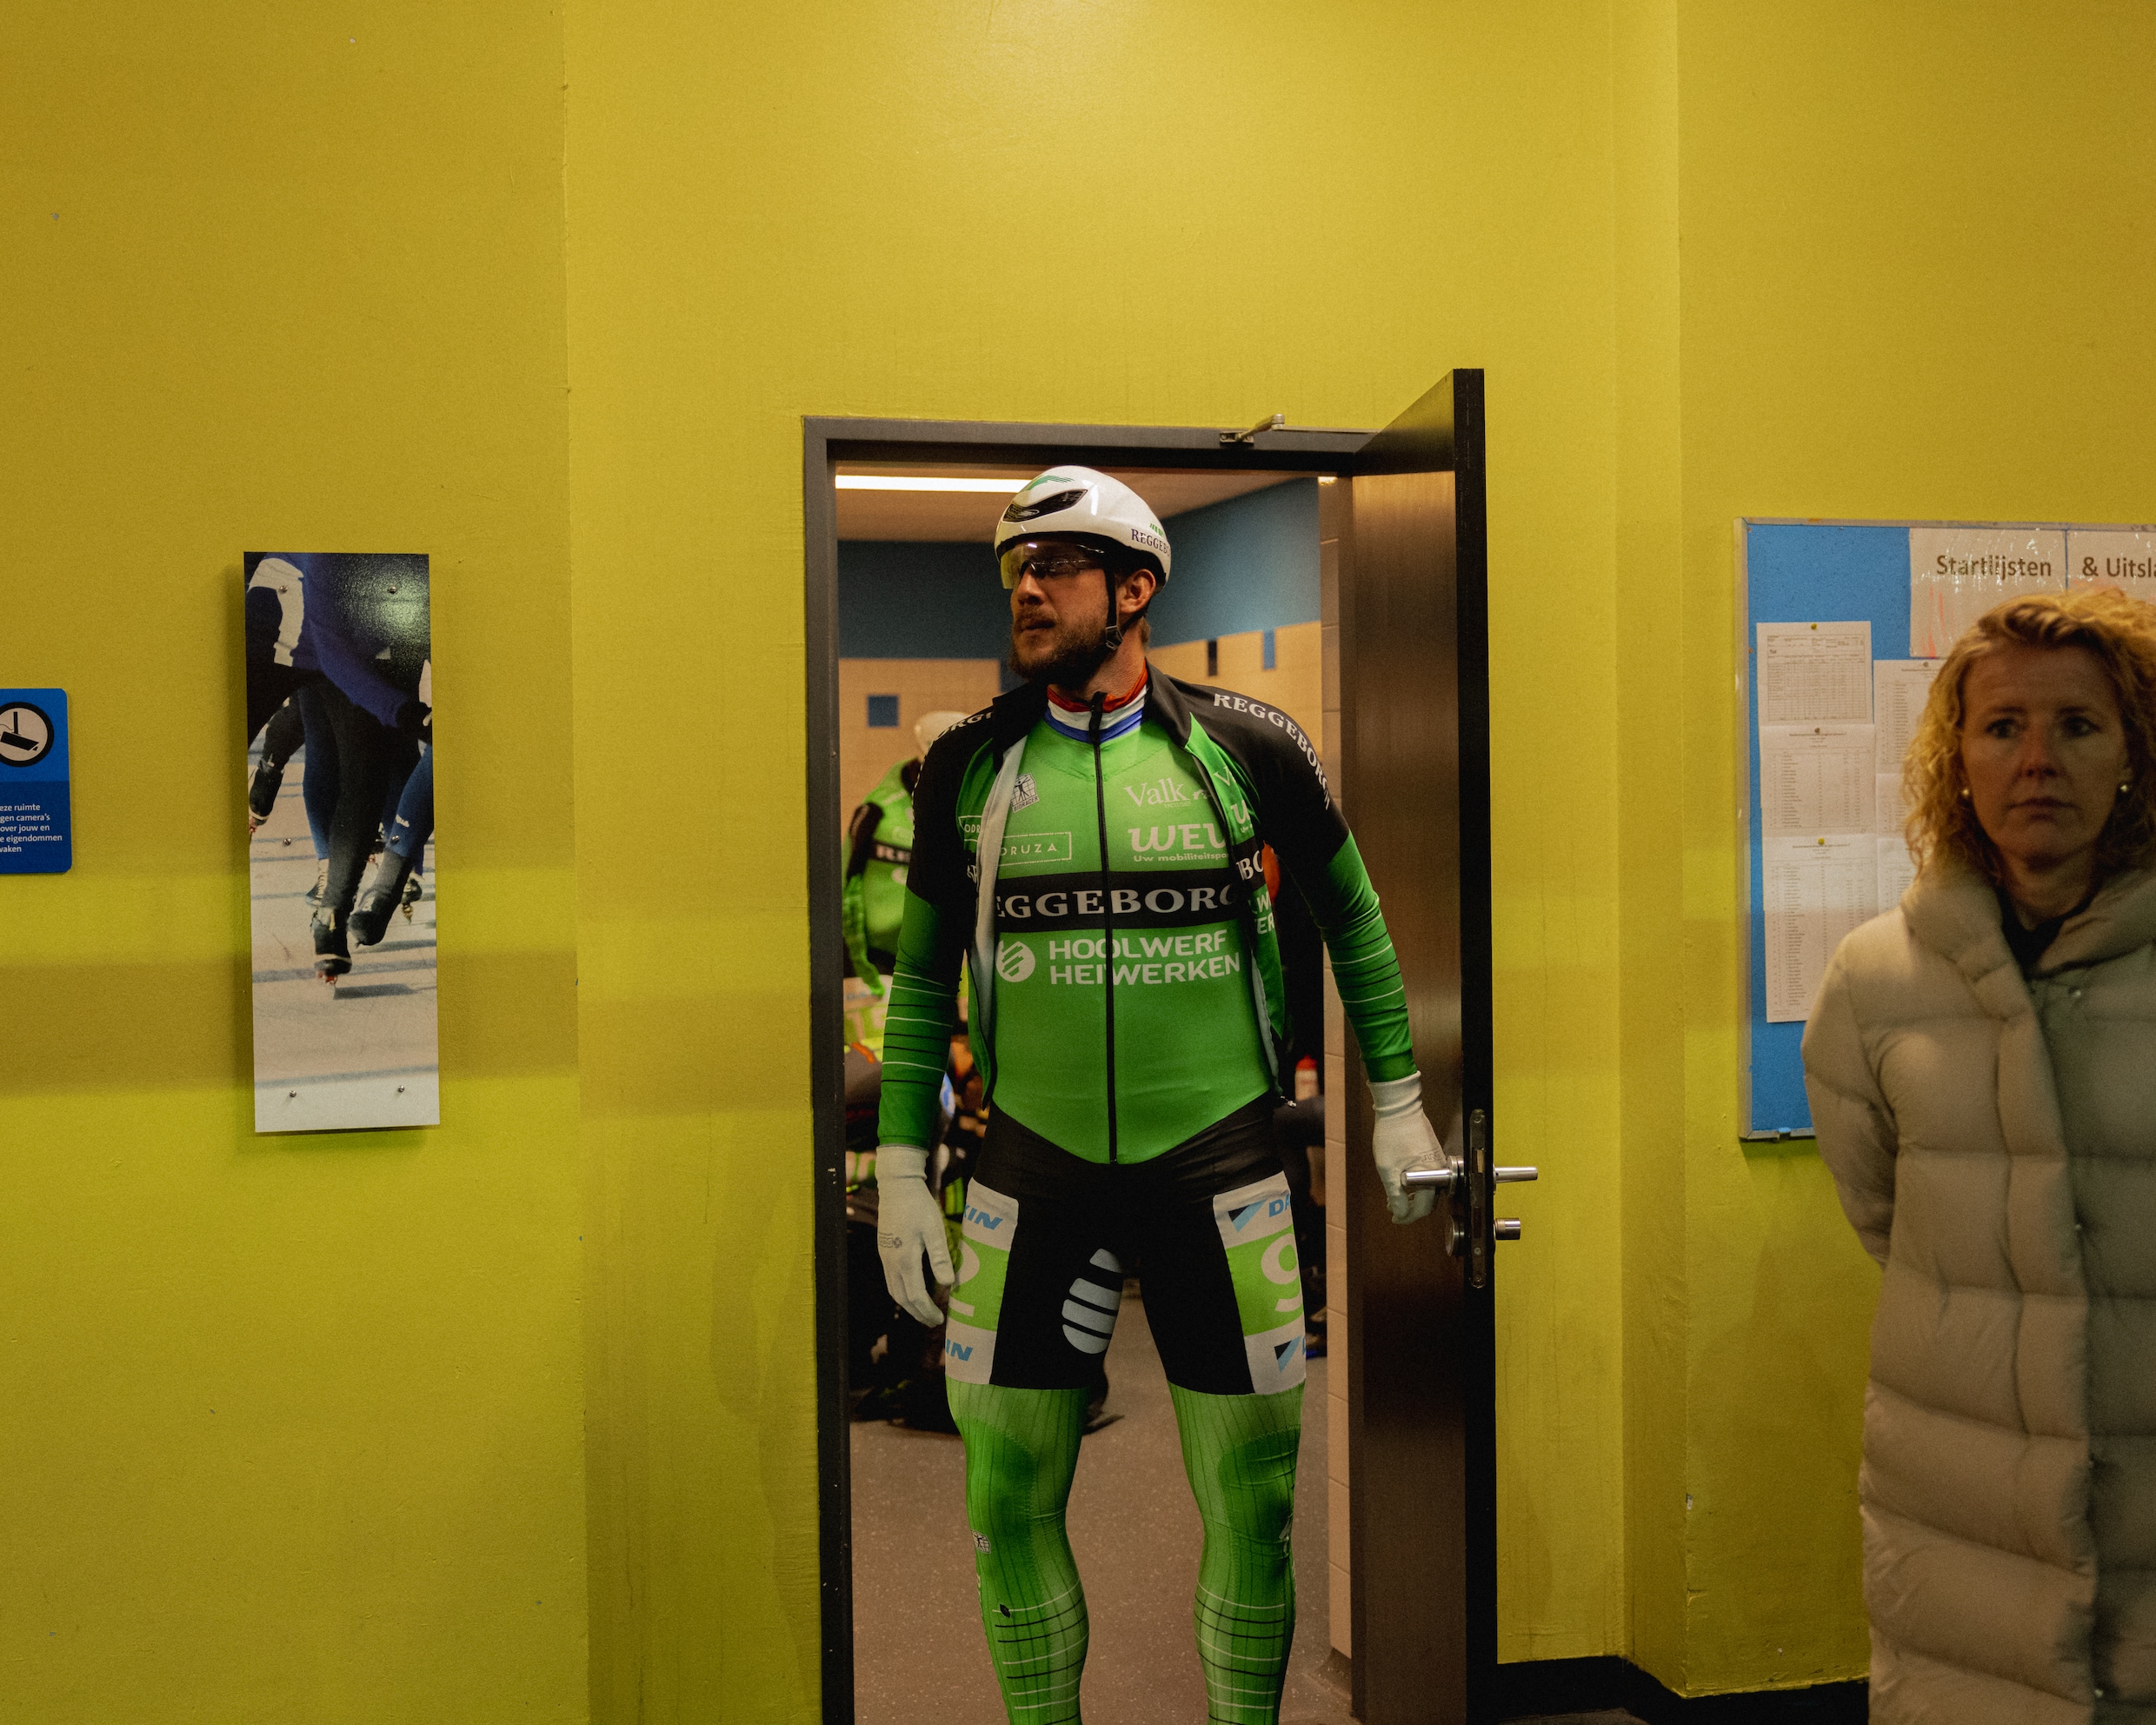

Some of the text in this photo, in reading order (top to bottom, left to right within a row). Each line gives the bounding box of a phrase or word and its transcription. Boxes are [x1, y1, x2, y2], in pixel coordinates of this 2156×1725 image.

[1936, 555, 2156, 580] Startlijsten & Uitsl
[1123, 777, 1190, 808] Valk
[1013, 796, 1039, 812] BIORACER
[17, 813, 50, 822] camera's
[6, 834, 63, 844] eigendommen
[18, 824, 38, 834] jouw
[1048, 929, 1228, 961] HOOLWERF
[1049, 952, 1241, 986] HEIWERKEN
